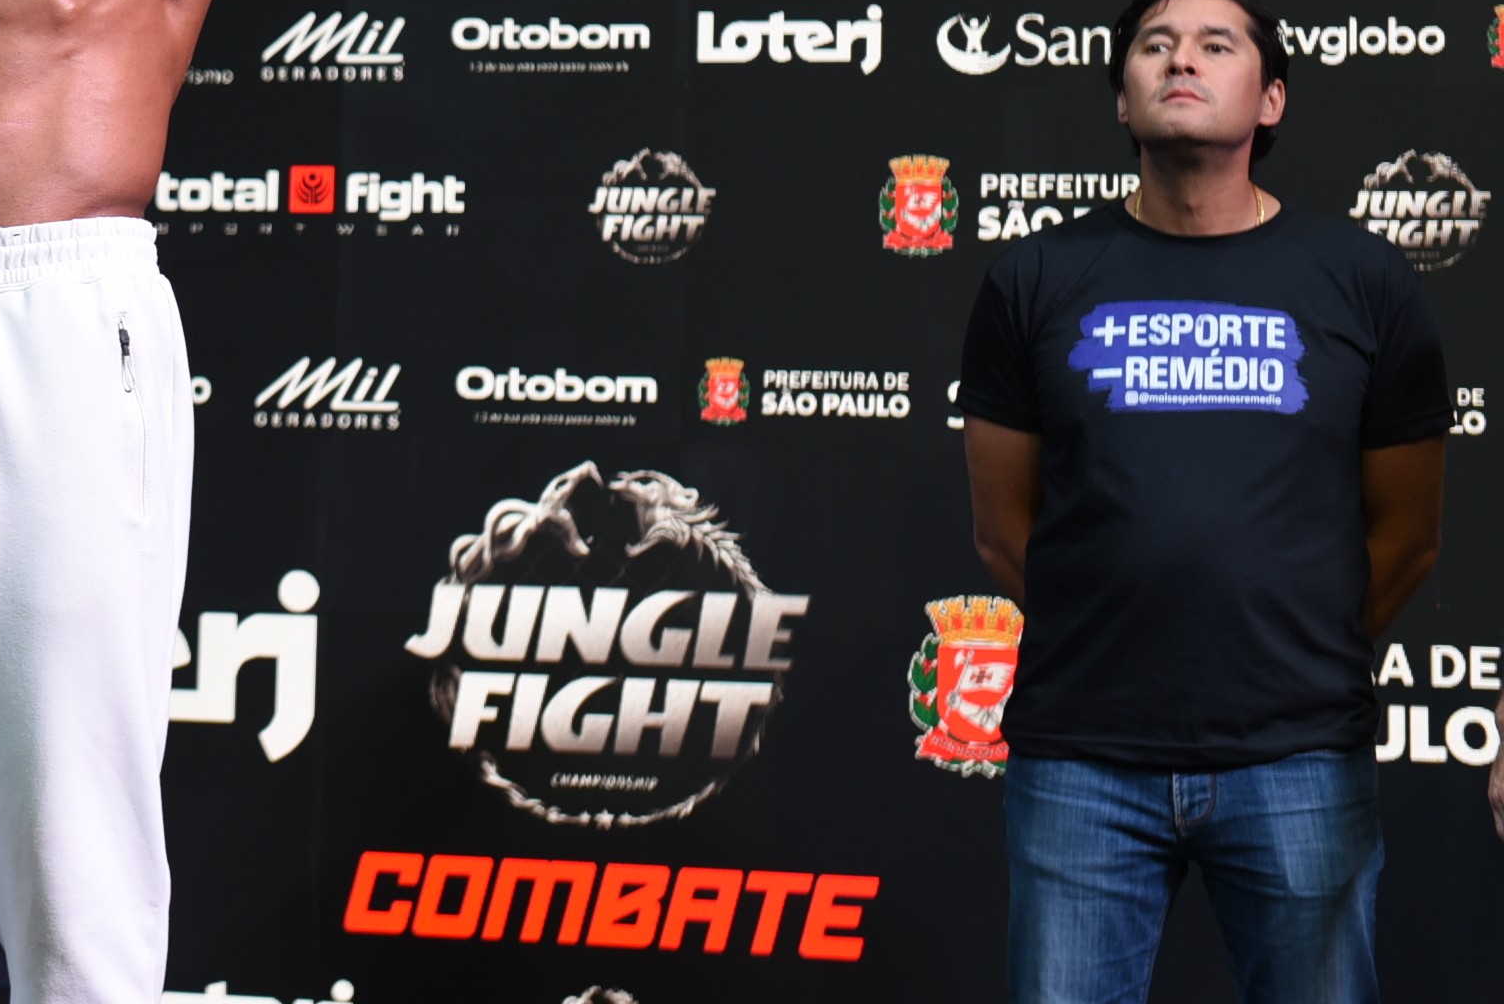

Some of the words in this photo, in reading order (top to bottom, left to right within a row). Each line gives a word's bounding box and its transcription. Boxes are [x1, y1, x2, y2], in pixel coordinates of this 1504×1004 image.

[451, 17, 650, 50] Ortobom
[697, 4, 883, 75] Loterj
[1277, 16, 1446, 66] tvglobo
[260, 66, 404, 82] GERADORES
[155, 169, 279, 212] total
[345, 172, 465, 221] fight
[587, 186, 717, 214] JUNGLE
[1348, 190, 1491, 219] JUNGLE
[602, 214, 705, 242] FIGHT
[456, 366, 658, 403] Ortobom
[763, 369, 879, 391] PREFEITURA
[883, 371, 909, 391] DE
[761, 385, 817, 416] SÃO
[822, 392, 910, 418] PAULO
[1457, 387, 1485, 407] DE
[253, 412, 400, 430] GERADORES
[404, 584, 811, 671] JUNGLE
[1430, 644, 1502, 691] DE
[449, 671, 774, 759] FIGHT
[551, 772, 659, 793] CHAMPIONSHIP
[343, 851, 881, 961] COMBATE
